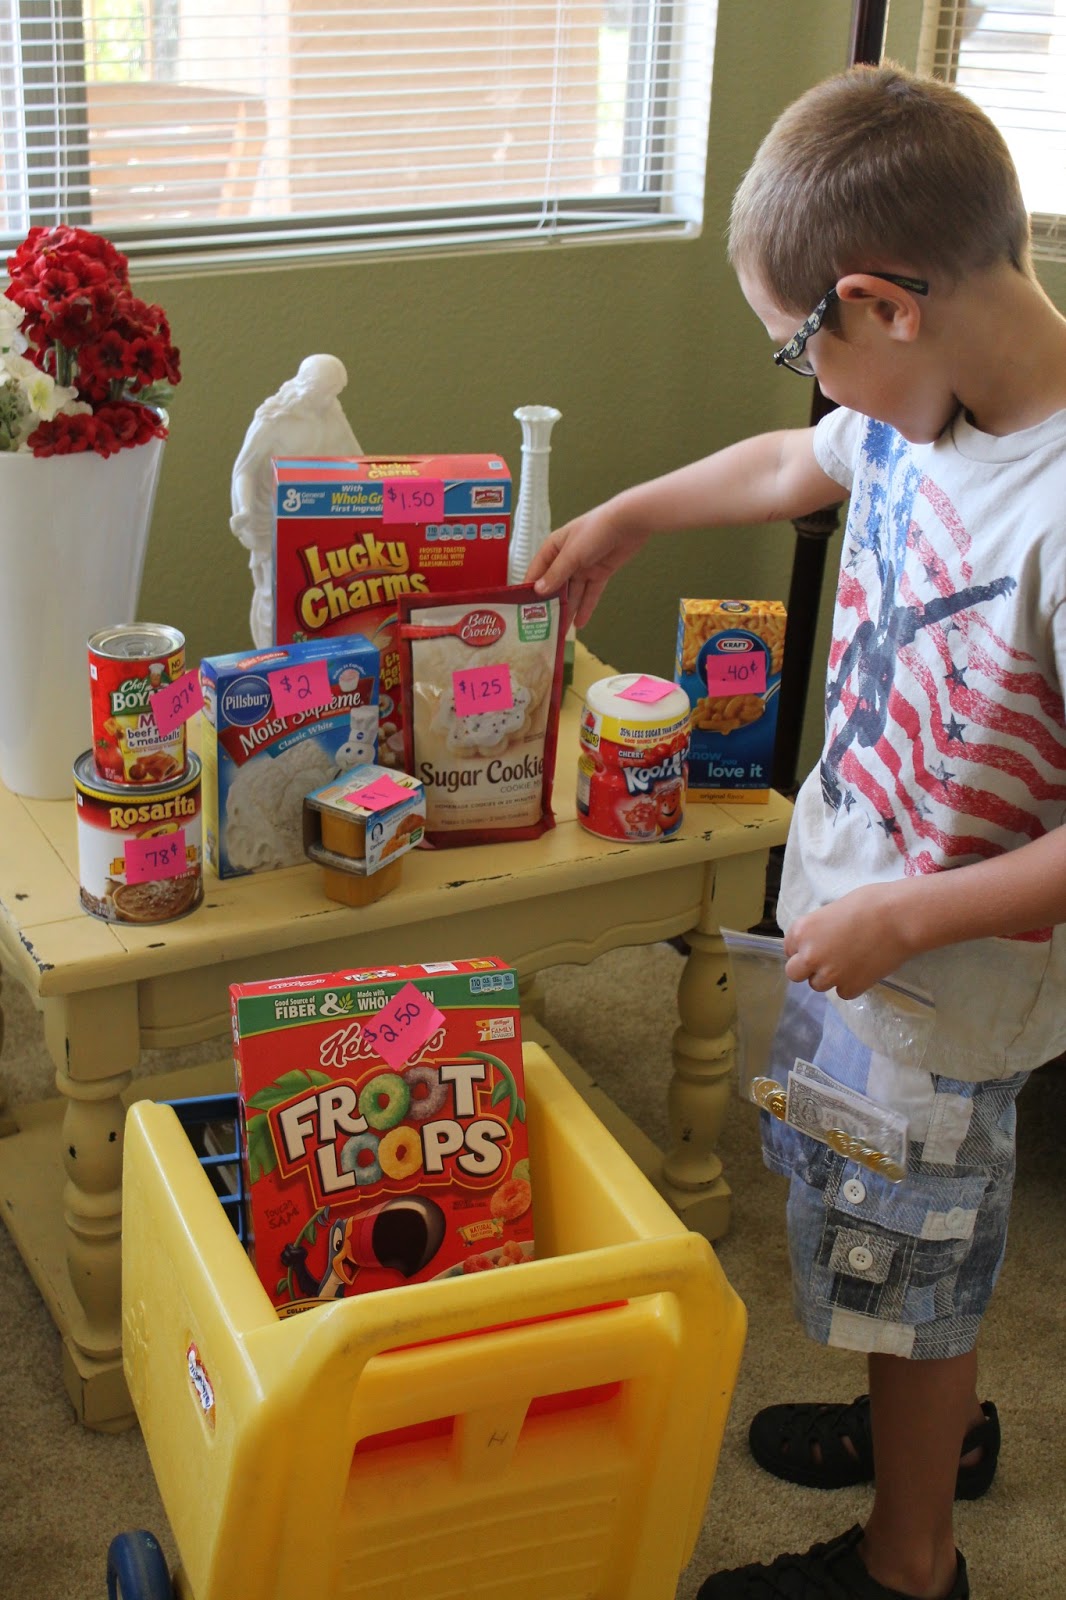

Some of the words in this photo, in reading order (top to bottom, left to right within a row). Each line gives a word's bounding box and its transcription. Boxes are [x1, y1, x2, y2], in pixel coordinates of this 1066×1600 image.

[332, 492, 366, 505] Whole
[387, 486, 435, 510] $1.50
[331, 505, 350, 513] First
[352, 504, 383, 514] Ingredi
[304, 532, 410, 584] Lucky
[300, 573, 431, 629] Charms
[467, 613, 497, 628] Betty
[460, 624, 501, 640] Crocker
[121, 678, 148, 693] Chef
[280, 675, 312, 699] $2
[225, 693, 271, 711] Pillsbury
[128, 727, 152, 739] beef
[239, 717, 288, 757] Moist
[278, 732, 307, 750] Classic
[308, 721, 334, 736] White
[631, 729, 645, 738] LESS
[645, 727, 661, 738] SUGAR
[618, 750, 645, 759] CHERRY
[420, 761, 483, 793] Sugar
[486, 753, 545, 784] Cookie
[708, 761, 744, 778] love
[750, 763, 763, 778] it
[500, 781, 531, 794] COOKIE
[109, 796, 196, 830] Rosarita
[274, 999, 289, 1007] Good
[290, 997, 308, 1005] Source
[309, 995, 316, 1003] of
[357, 990, 372, 998] Made
[373, 988, 385, 996] with
[357, 994, 397, 1011] WHO
[275, 1003, 317, 1020] FIBER
[363, 1002, 420, 1043] $2.50
[491, 1026, 513, 1034] FAMILY
[279, 1063, 487, 1163] FROOT
[317, 1119, 507, 1195] LOOPS
[469, 1223, 492, 1234] NATURAL
